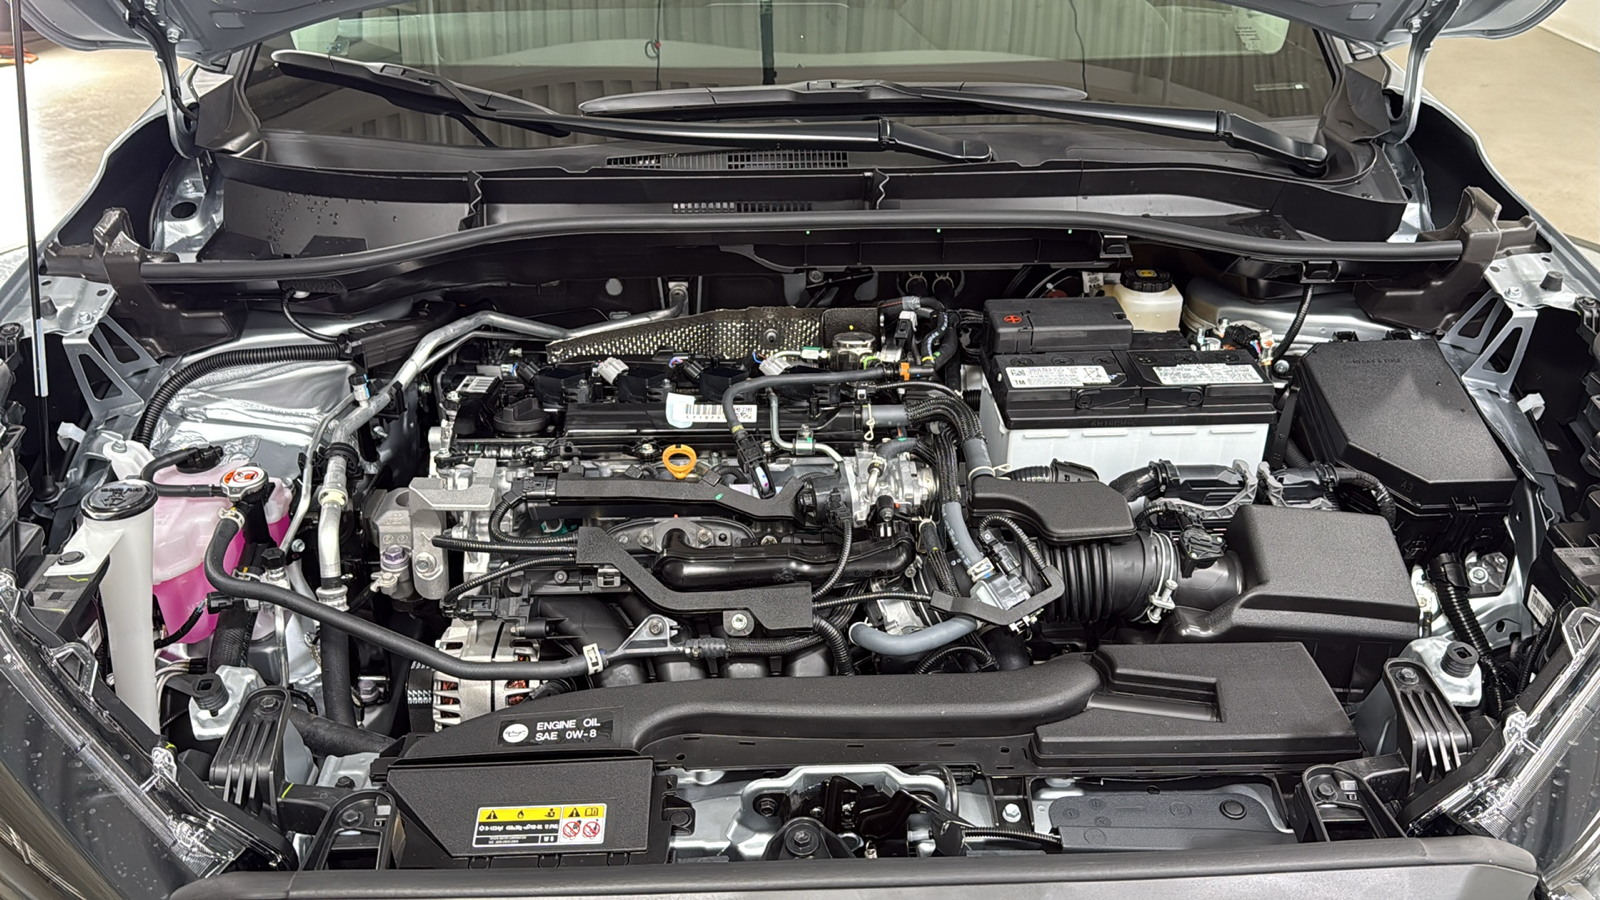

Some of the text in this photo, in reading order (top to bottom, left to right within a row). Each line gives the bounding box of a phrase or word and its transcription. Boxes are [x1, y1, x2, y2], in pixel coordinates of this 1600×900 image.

[536, 717, 601, 731] ENGINE OIL
[535, 728, 597, 741] SAE 0W-8
